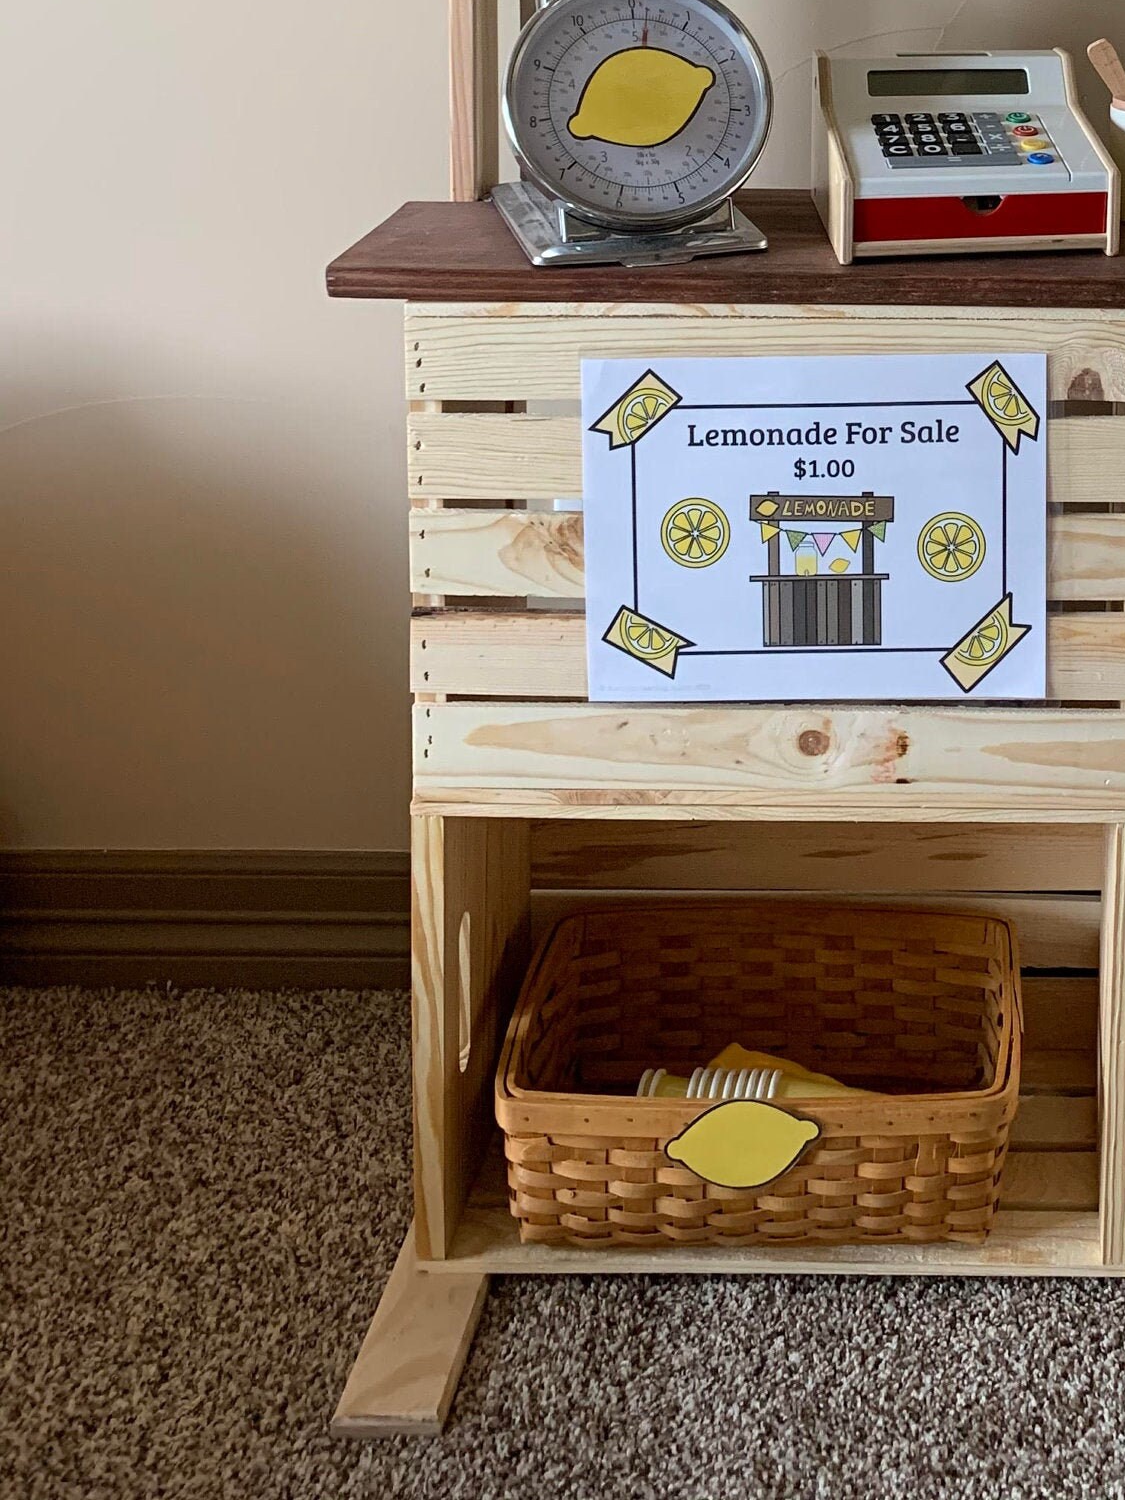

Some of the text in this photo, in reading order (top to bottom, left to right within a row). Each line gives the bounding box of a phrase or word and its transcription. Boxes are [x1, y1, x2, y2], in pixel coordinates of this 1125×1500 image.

[570, 14, 584, 27] 10
[534, 59, 541, 71] 9
[744, 104, 751, 117] 3
[529, 115, 537, 128] 8
[883, 123, 966, 133] 4 5 6
[886, 134, 937, 143] 7 8
[889, 145, 908, 154] C
[687, 419, 960, 448] Lemonade For Sale
[793, 457, 855, 480] $1.00
[781, 499, 875, 519] LEMONADE
